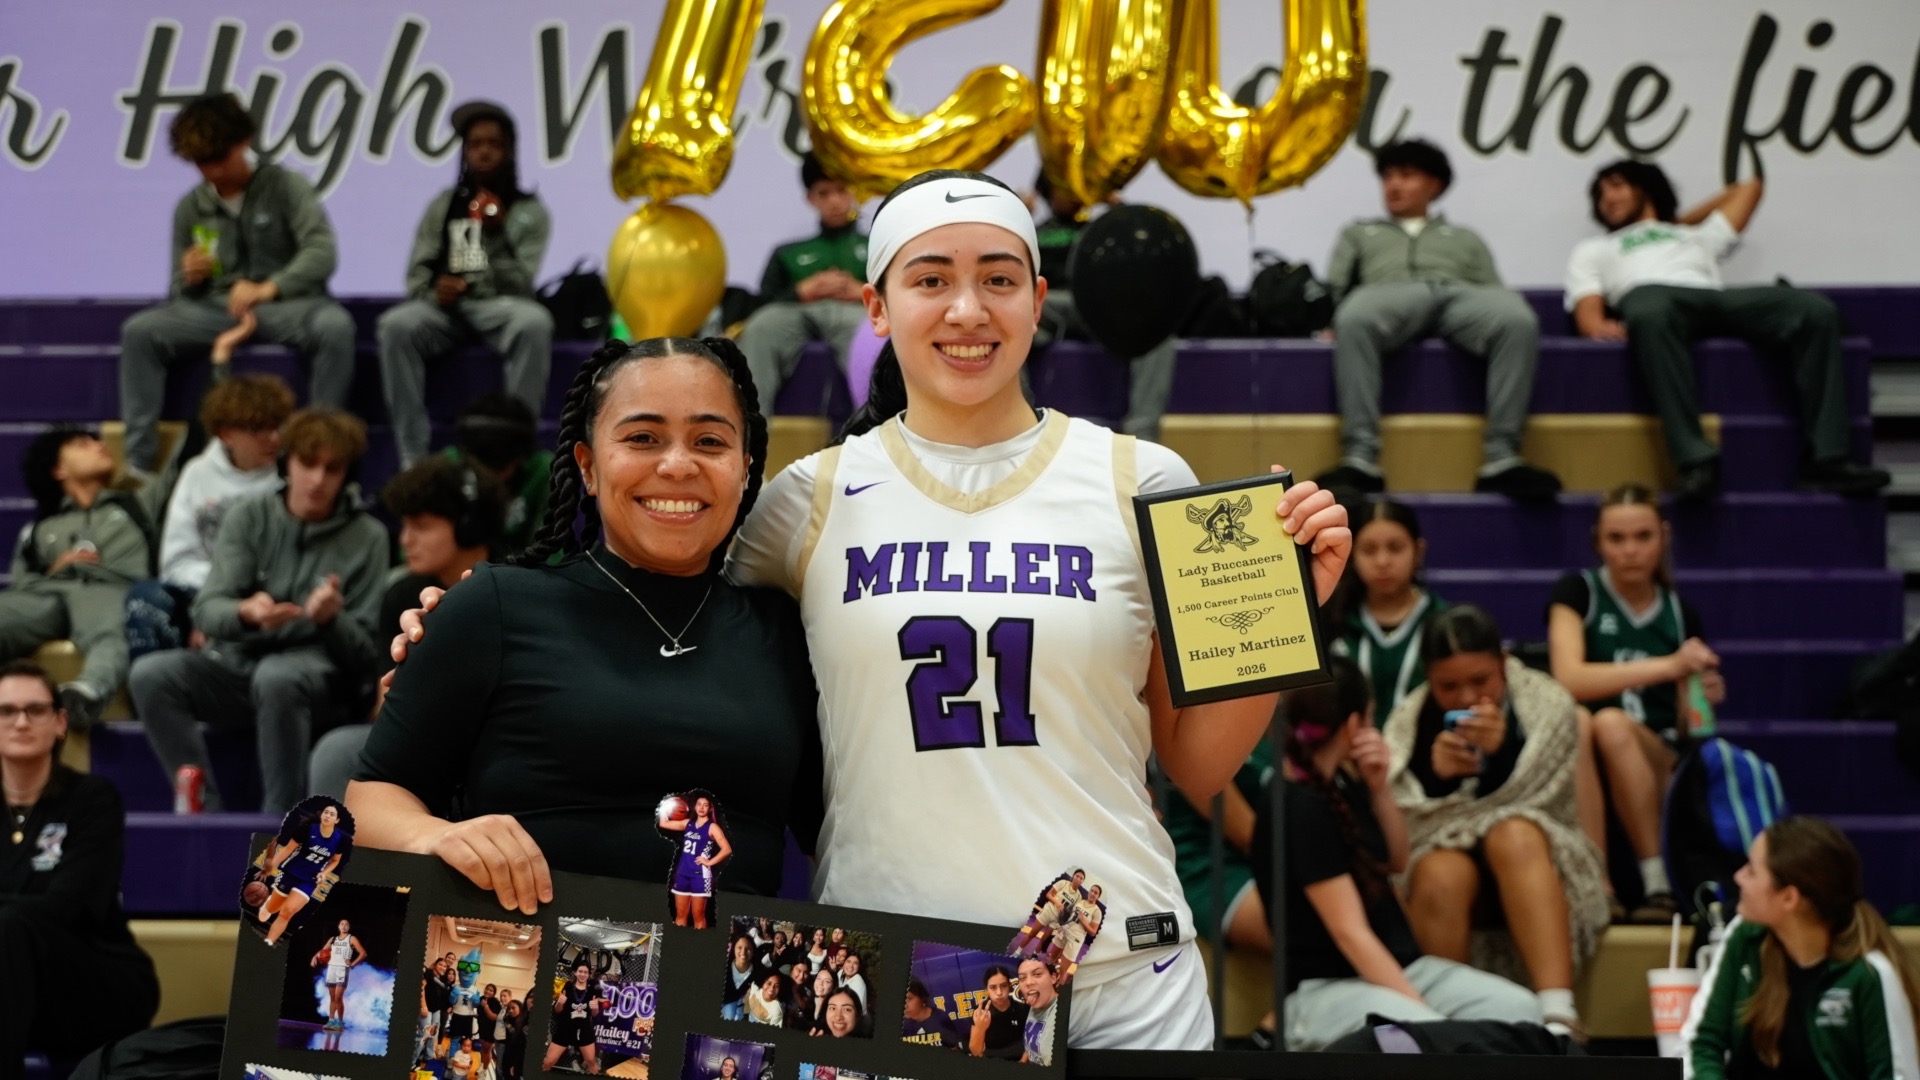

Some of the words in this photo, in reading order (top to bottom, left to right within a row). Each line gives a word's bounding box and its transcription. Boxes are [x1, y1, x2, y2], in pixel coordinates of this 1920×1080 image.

[122, 22, 460, 198] High
[1460, 14, 1689, 155] the
[843, 541, 1097, 604] MILLER
[1178, 565, 1208, 578] Lady
[1212, 554, 1283, 573] Buccaneers
[1200, 568, 1266, 587] Basketball
[1177, 602, 1202, 614] 1,500
[1204, 598, 1238, 609] Career
[1240, 591, 1273, 603] Points
[1274, 586, 1299, 597] Club
[1188, 646, 1236, 661] Hailey
[1239, 634, 1306, 653] Martinez
[1236, 663, 1267, 677] 2026
[897, 615, 1040, 752] 21
[683, 839, 697, 855] 21
[1163, 921, 1173, 936] M
[594, 1024, 630, 1043] Hailey
[626, 1040, 641, 1050] #21
